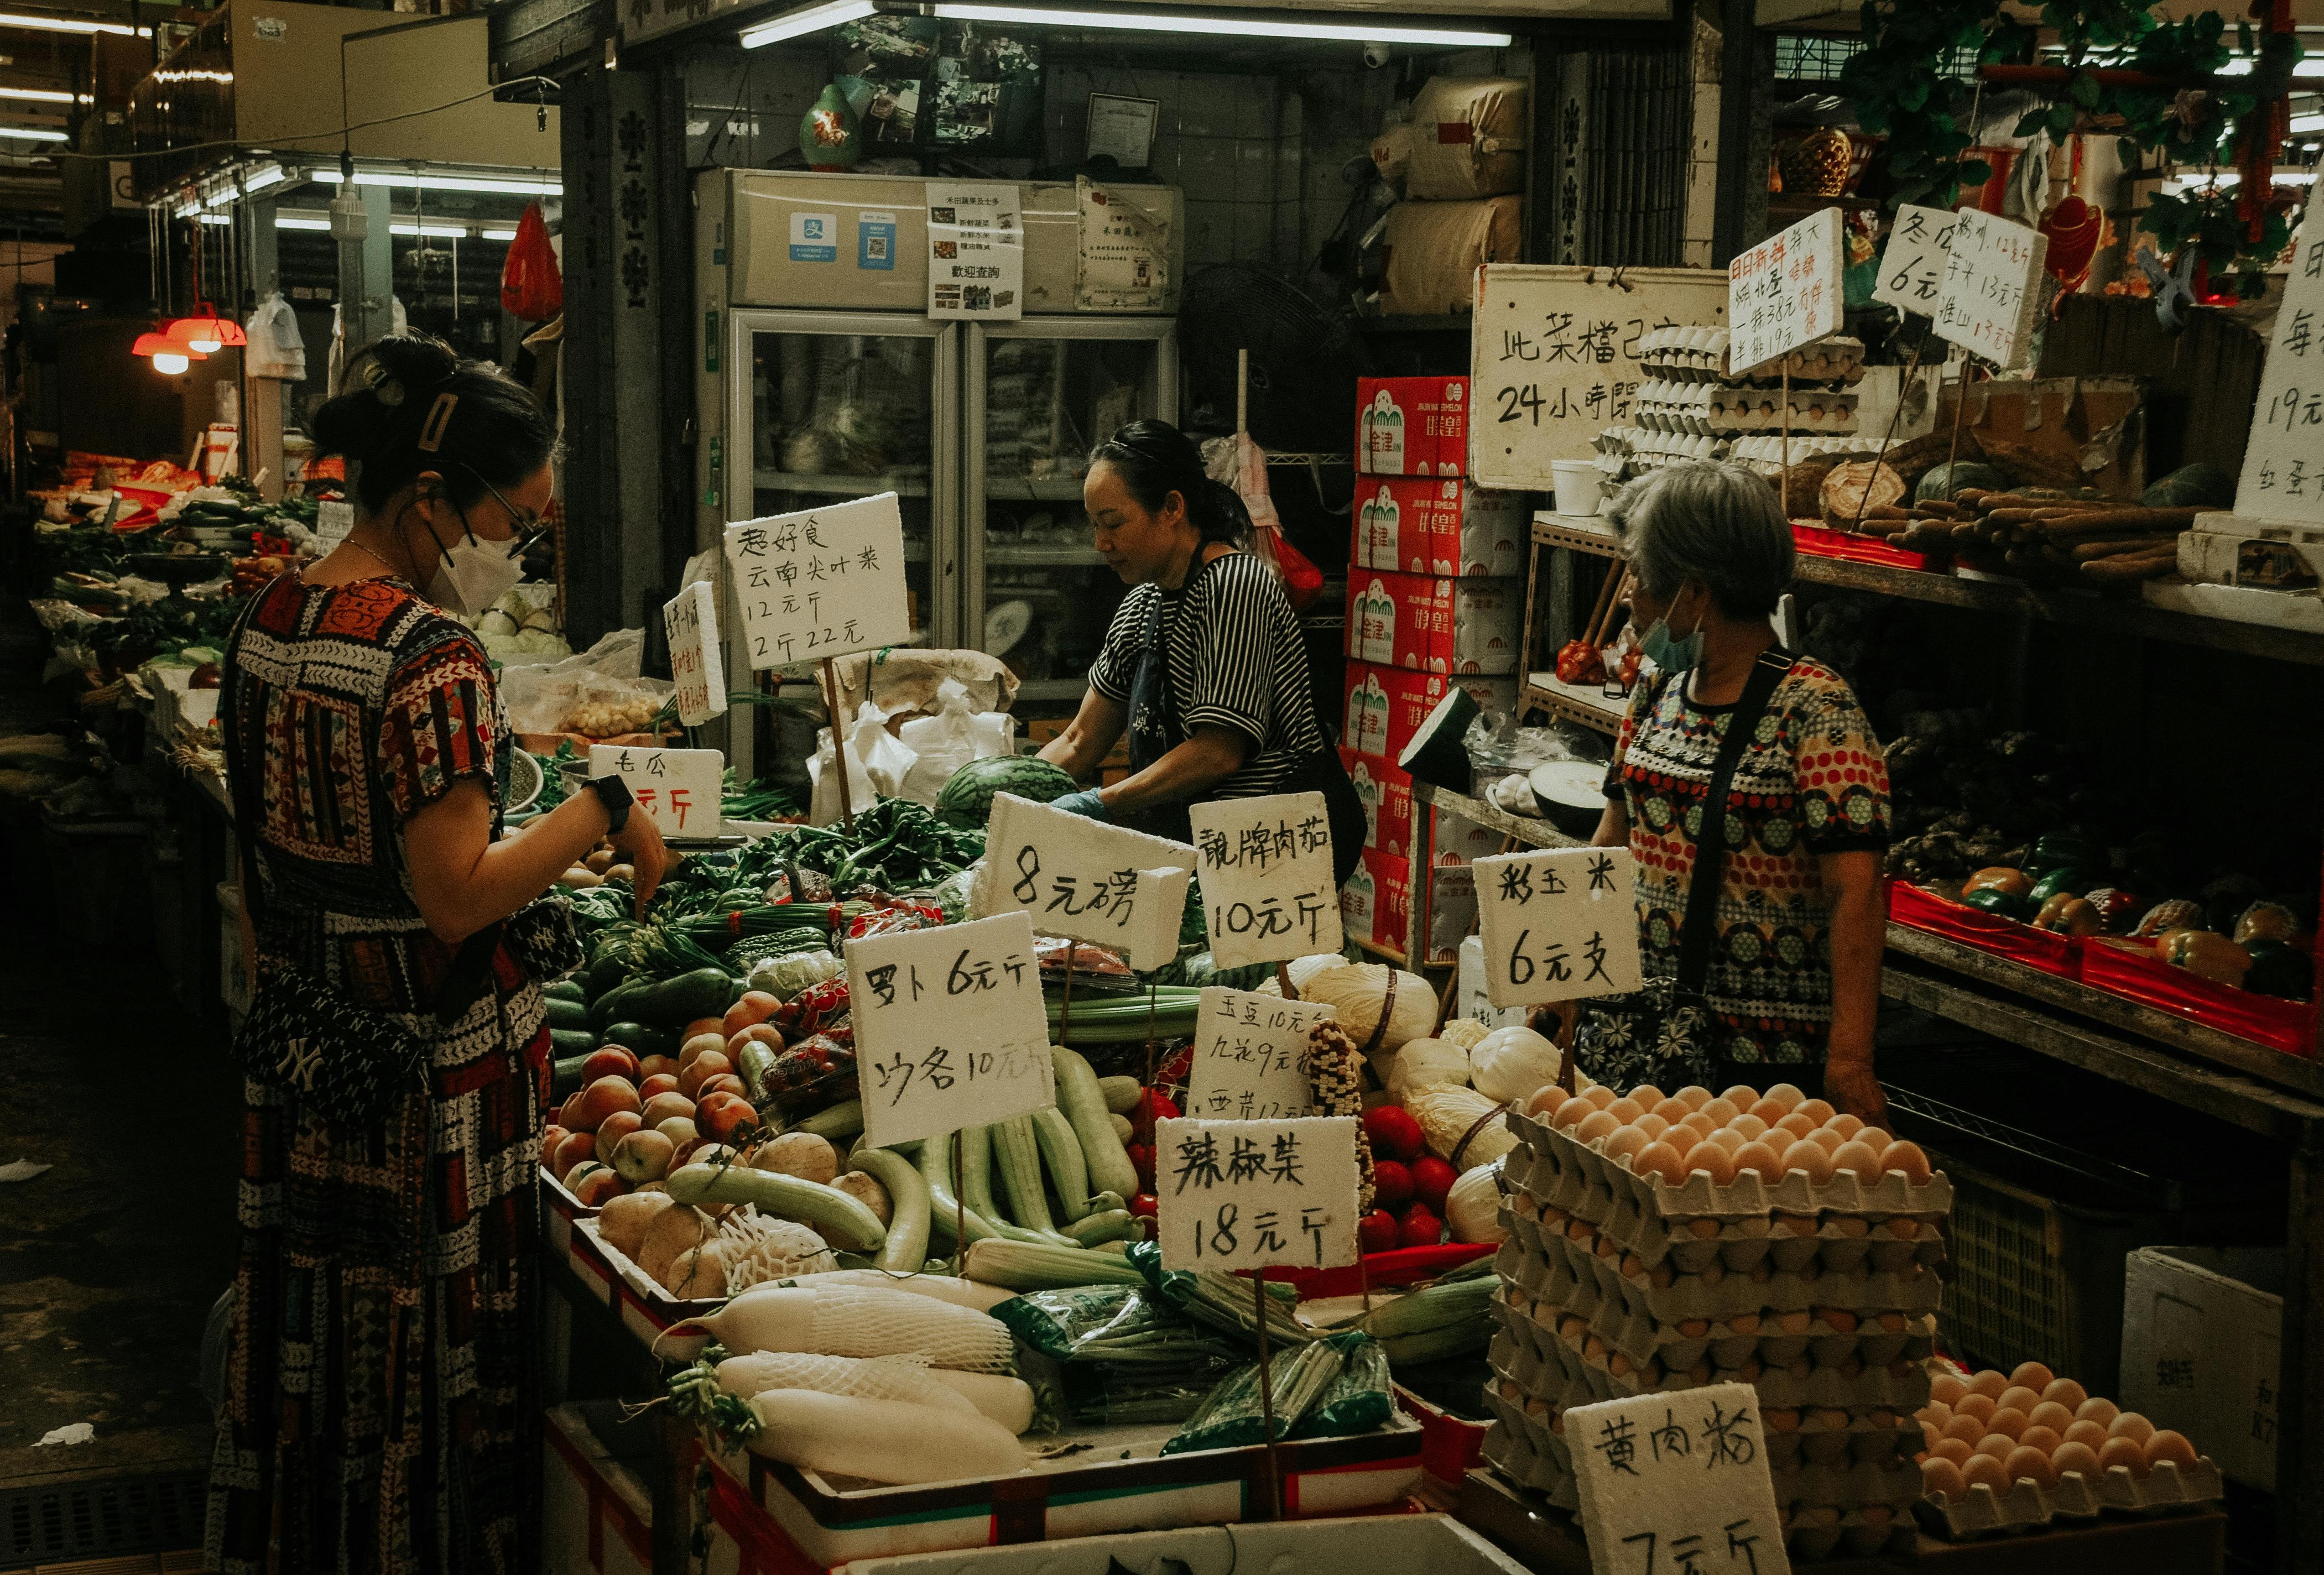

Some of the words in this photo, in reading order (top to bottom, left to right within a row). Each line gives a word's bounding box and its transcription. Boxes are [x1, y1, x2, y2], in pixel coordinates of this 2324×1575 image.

[1900, 212, 1956, 255] 冬瓜
[952, 265, 999, 278] 歡迎查詢
[1890, 256, 1937, 299] 6元
[2282, 309, 2324, 356] 每
[738, 515, 828, 557] 超好食
[748, 545, 880, 588] 云南尖叶菜
[748, 592, 821, 624] 12元斤
[615, 750, 666, 778] 毛瓜
[1199, 816, 1328, 870] 靚牌肉茄
[1013, 845, 1138, 927] 8元磅
[1497, 852, 1617, 906] 彩玉米
[1215, 891, 1326, 945] 10元斤
[866, 963, 925, 1009] 罗卜
[947, 950, 1027, 996] 6元斤
[1510, 929, 1615, 987] 6元支
[1173, 1131, 1304, 1195] 辣椒菜
[1195, 1203, 1322, 1265] 18元斤
